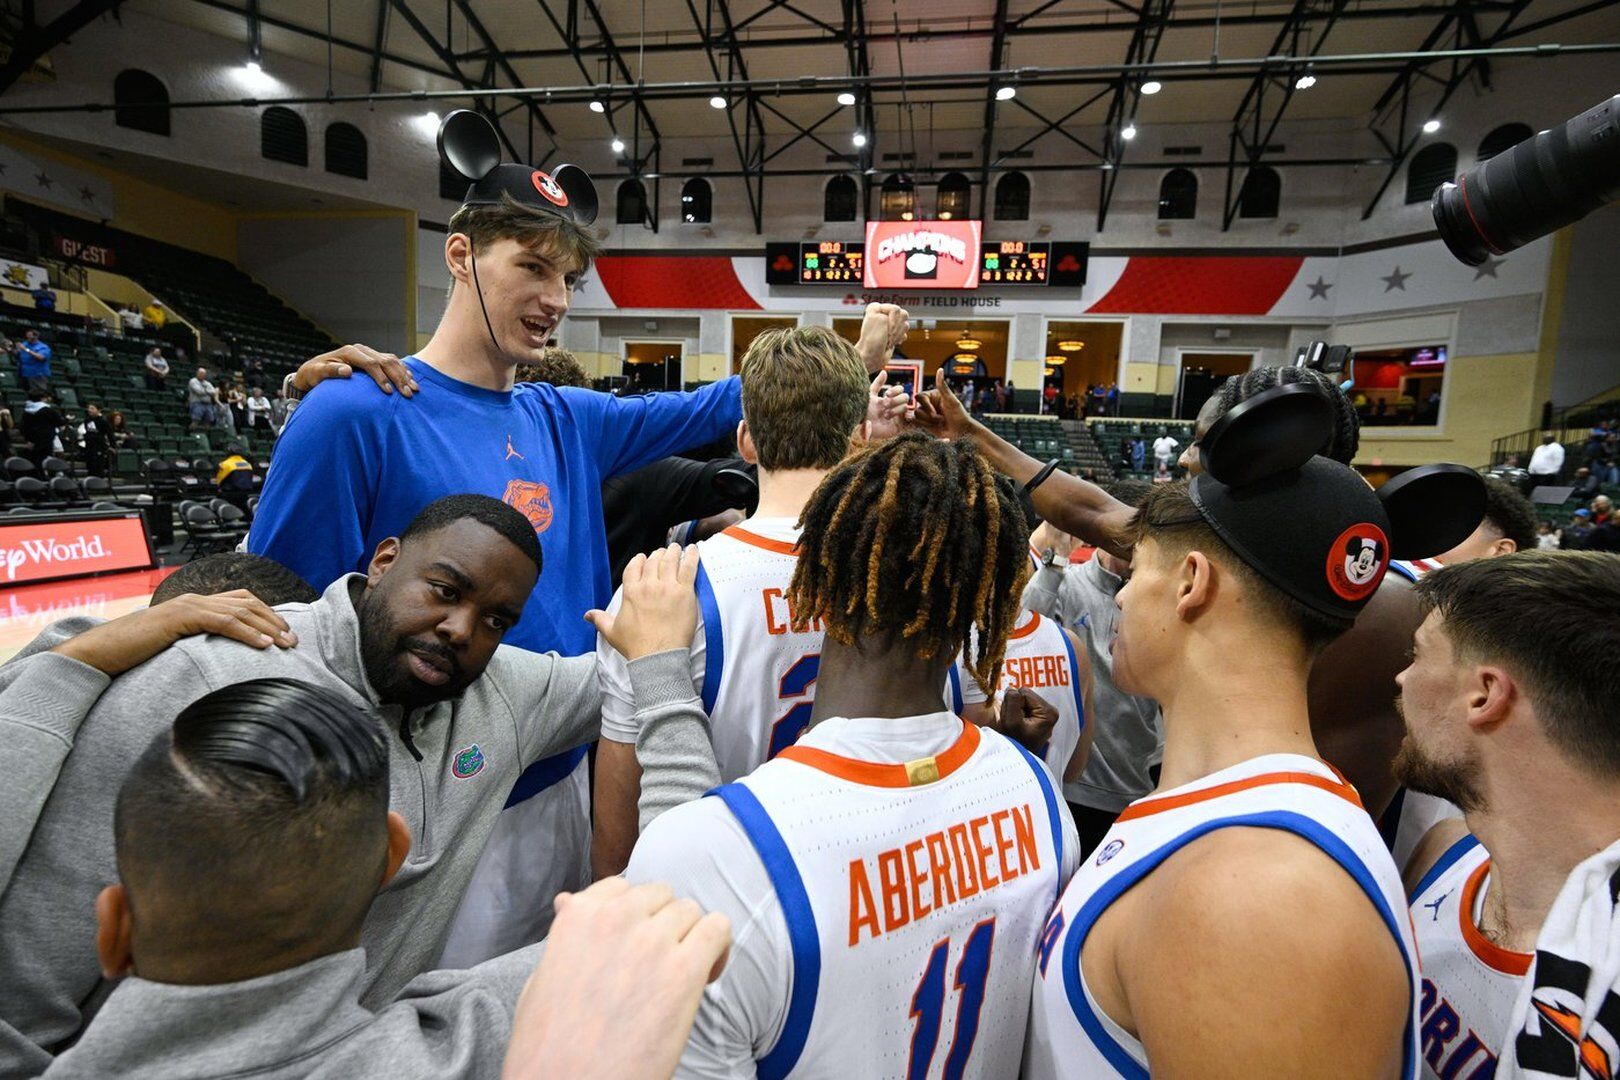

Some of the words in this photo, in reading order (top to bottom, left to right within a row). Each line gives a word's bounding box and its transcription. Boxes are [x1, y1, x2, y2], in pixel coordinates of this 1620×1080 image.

[923, 296, 958, 307] FIELD
[961, 296, 1002, 307] HOUSE
[848, 804, 1041, 948] ABERDEEN
[906, 916, 996, 1080] 11
